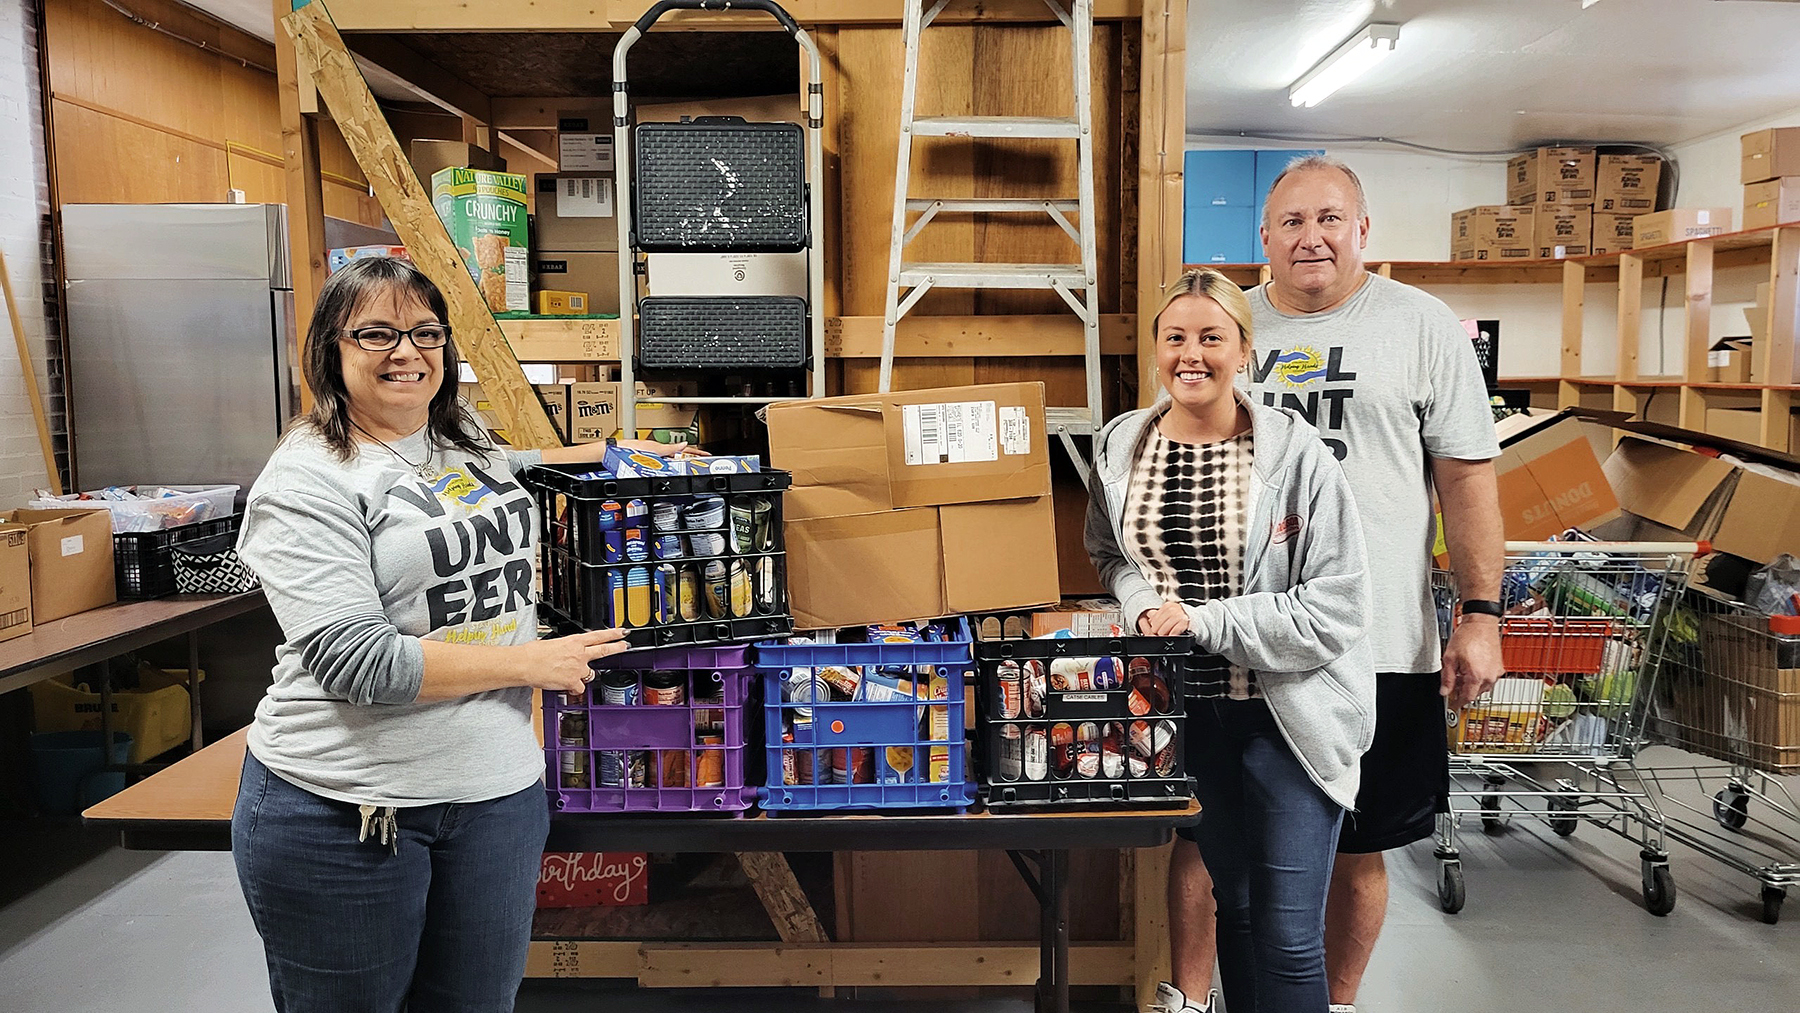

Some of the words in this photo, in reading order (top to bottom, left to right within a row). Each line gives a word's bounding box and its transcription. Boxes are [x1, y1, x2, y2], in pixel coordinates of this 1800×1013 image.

[455, 169, 492, 185] NATURE
[493, 175, 524, 192] VALLEY
[482, 186, 509, 196] POUCHES
[466, 200, 517, 223] CRUNCHY
[1685, 227, 1722, 237] SPAGHETTI
[1521, 481, 1593, 525] DONUTS
[425, 497, 533, 578] UNT
[426, 559, 533, 632] EER
[74, 703, 119, 713] BRUE
[538, 852, 647, 902] irthday
